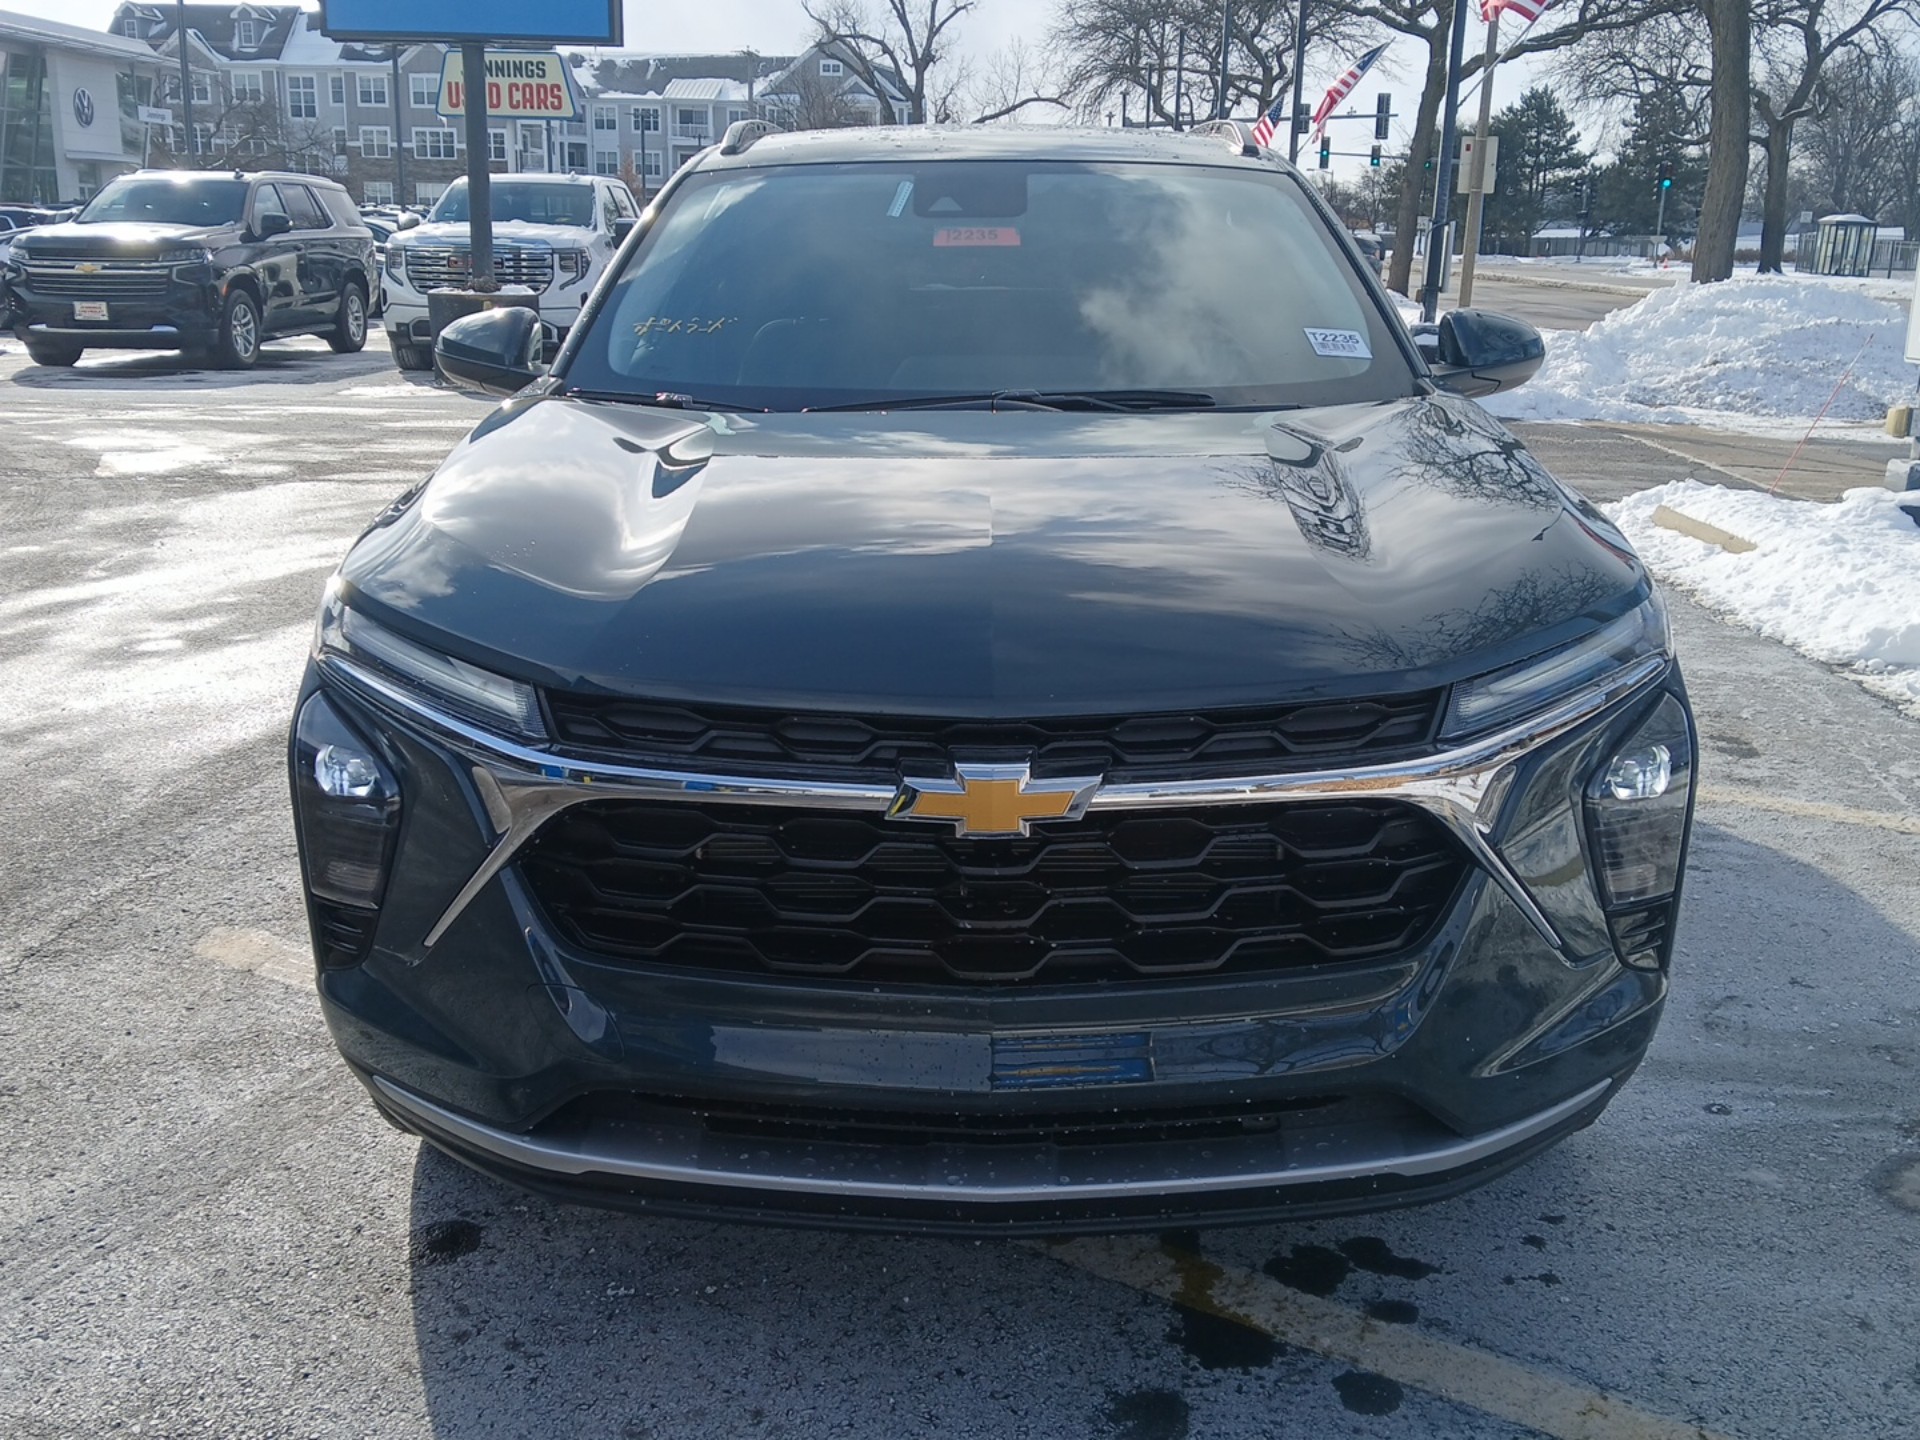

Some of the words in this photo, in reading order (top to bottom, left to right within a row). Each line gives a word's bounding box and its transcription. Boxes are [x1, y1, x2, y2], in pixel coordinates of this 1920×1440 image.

[461, 60, 547, 79] NNINGS
[447, 81, 501, 109] UD
[508, 83, 564, 110] CARS
[1308, 332, 1360, 344] T2235
